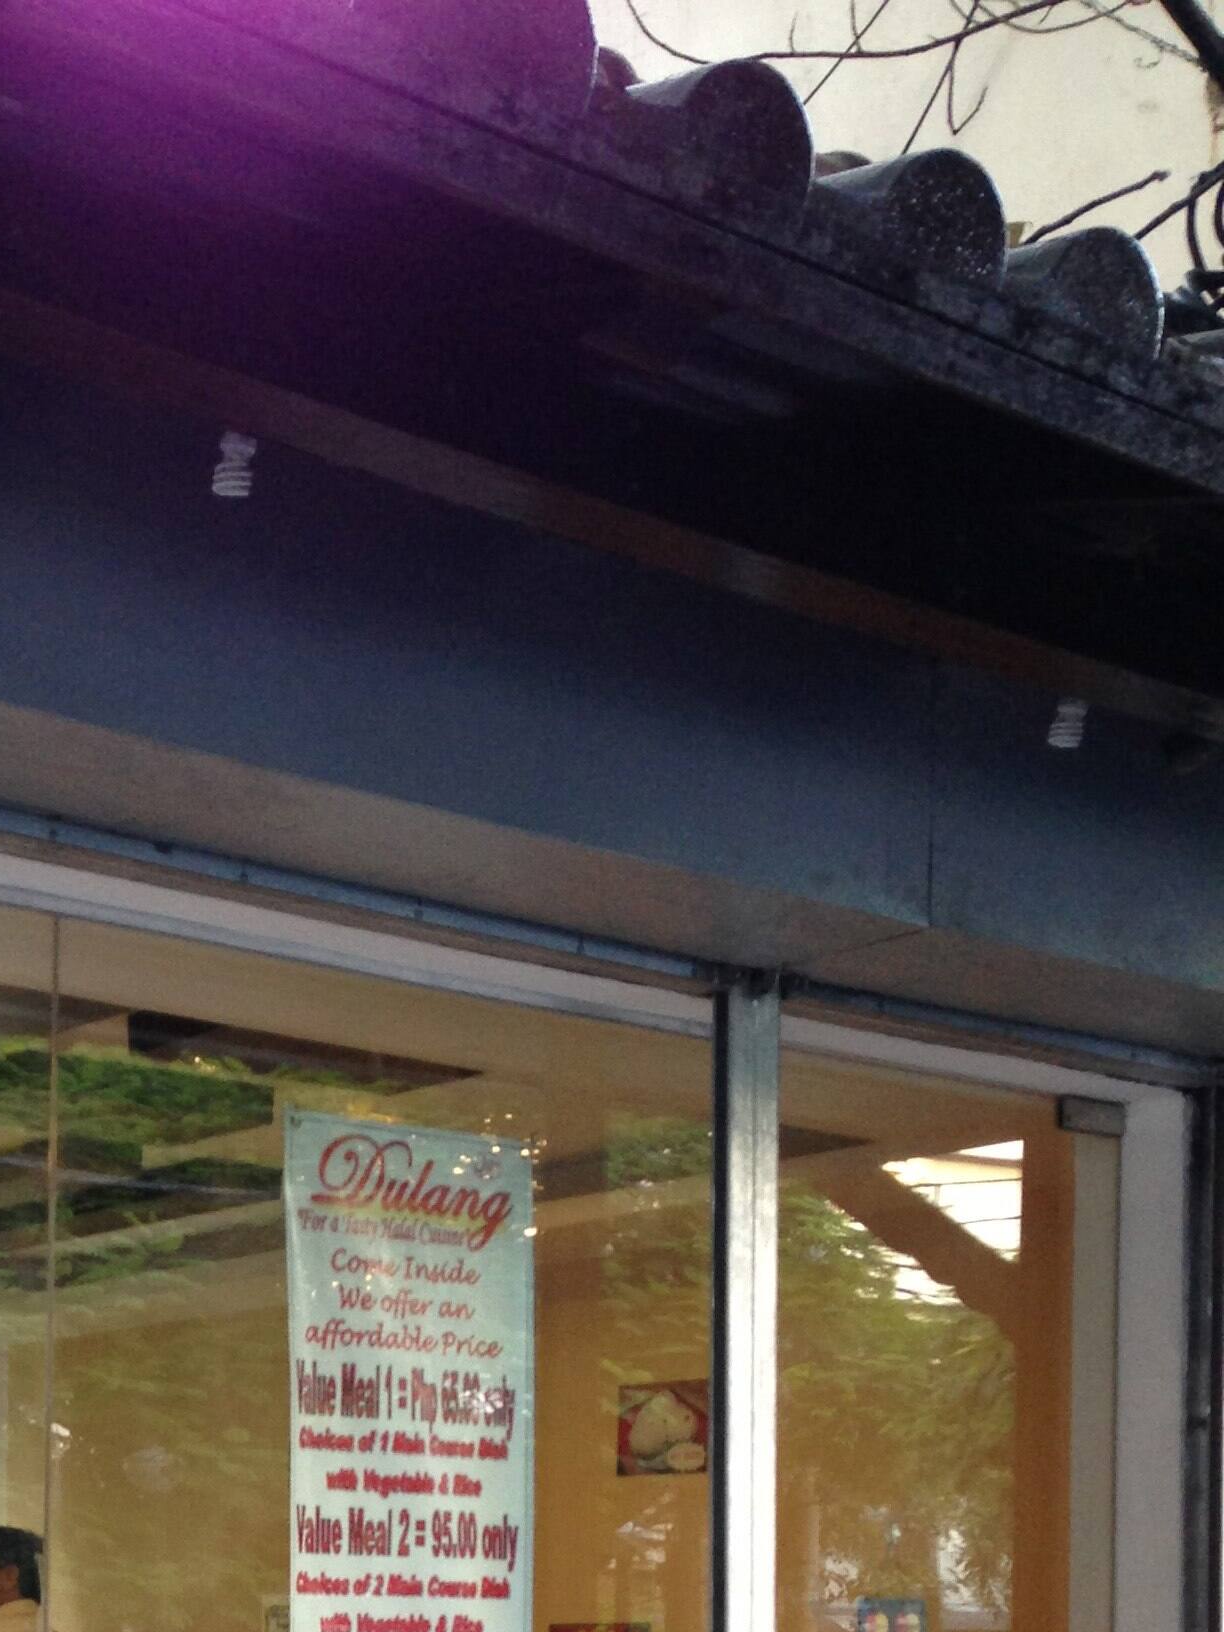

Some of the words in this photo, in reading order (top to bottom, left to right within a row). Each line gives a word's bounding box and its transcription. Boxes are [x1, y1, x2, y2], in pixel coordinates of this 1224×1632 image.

[311, 1133, 513, 1252] Dulang
[331, 1248, 399, 1277] Come
[404, 1257, 481, 1285] Inside
[337, 1285, 374, 1312] We
[380, 1289, 432, 1319] offer
[439, 1301, 474, 1321] an
[305, 1317, 437, 1352] affordable
[442, 1330, 503, 1359] Price
[296, 1359, 336, 1416] Value
[341, 1363, 379, 1419] Meal
[385, 1364, 392, 1420] 1
[299, 1425, 354, 1450] Choices
[358, 1429, 376, 1454] of
[392, 1430, 425, 1454] Main
[430, 1434, 474, 1458] Course
[478, 1436, 508, 1460] Dish
[326, 1468, 357, 1491] with
[364, 1467, 434, 1499] Vegetable
[453, 1473, 482, 1496] Rice
[296, 1503, 342, 1555] Value
[348, 1507, 392, 1556] Meal
[397, 1509, 410, 1557] 2
[431, 1510, 477, 1559] 95.00
[482, 1515, 518, 1572] only
[296, 1571, 350, 1594] Choices
[353, 1572, 371, 1596] of
[373, 1573, 384, 1596] 2
[387, 1573, 423, 1596] Main
[428, 1574, 476, 1598] Course
[480, 1576, 510, 1599] Dish
